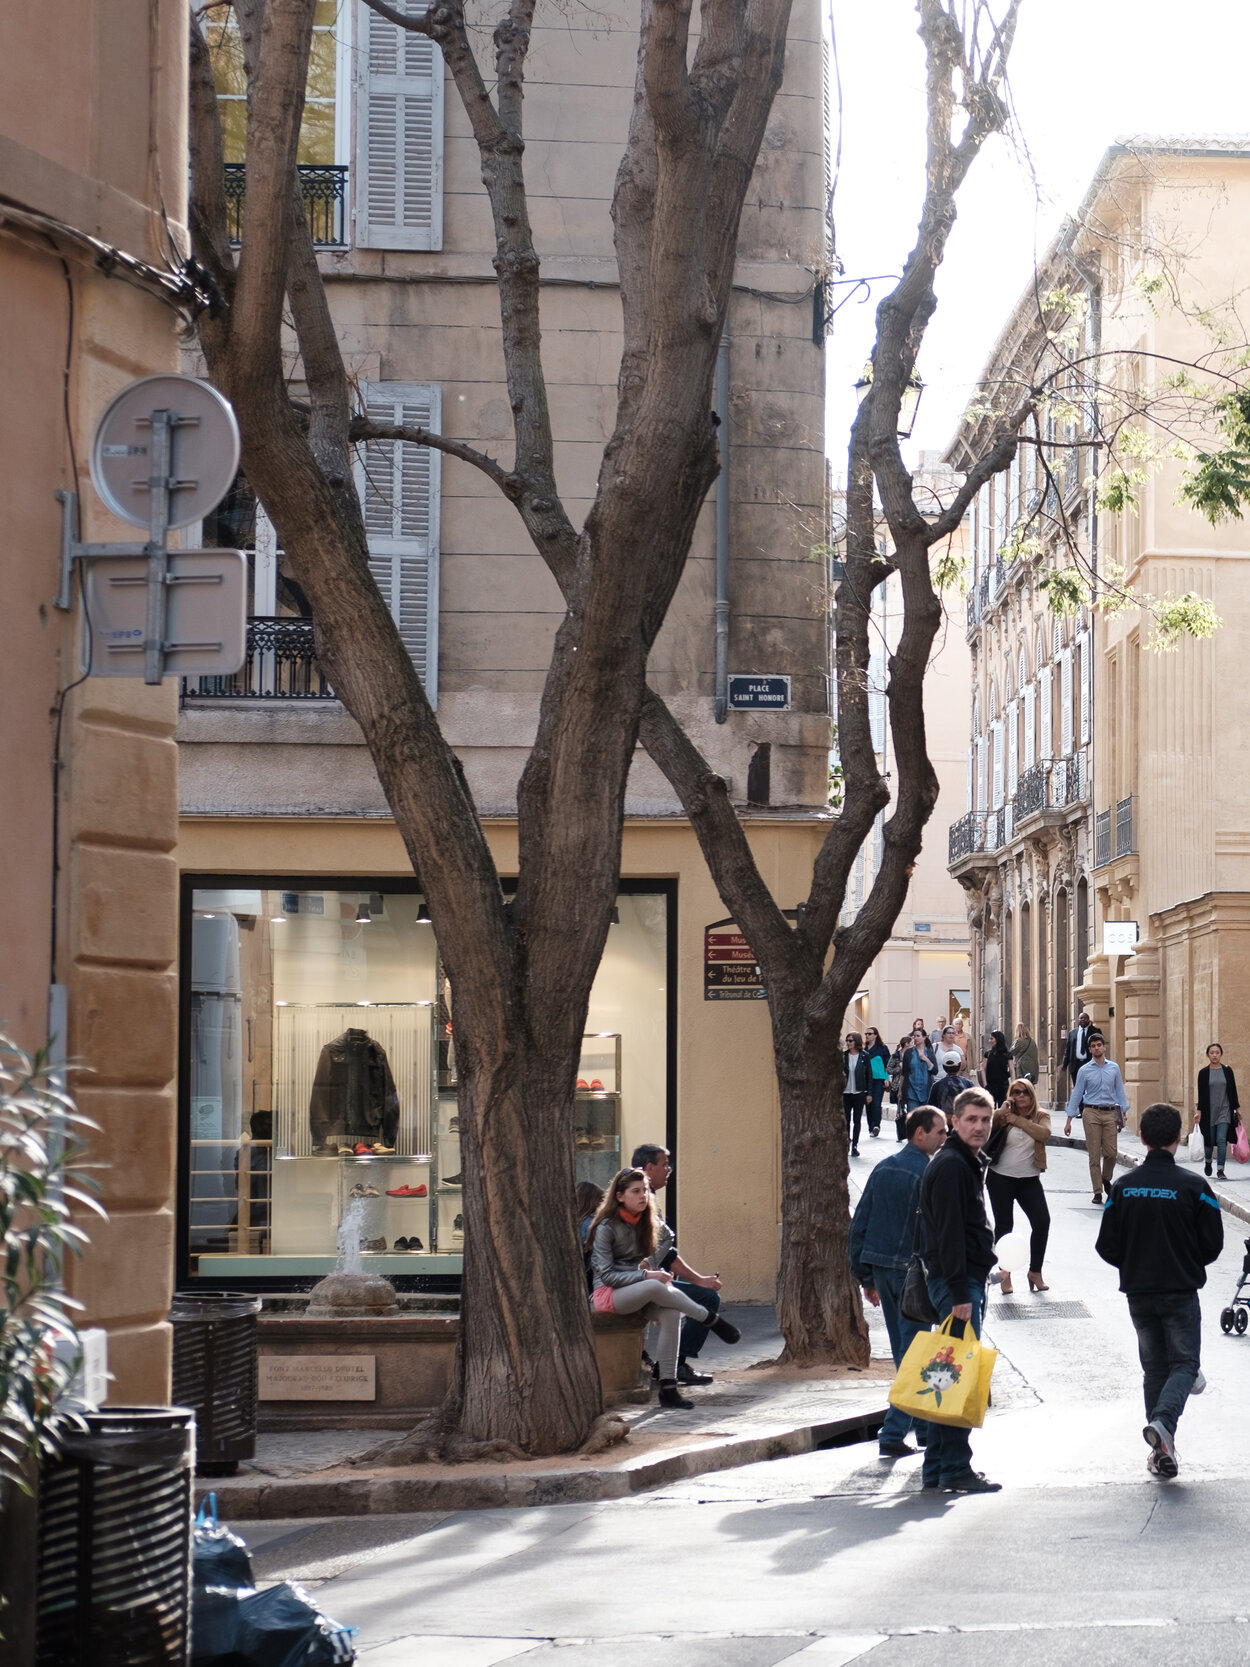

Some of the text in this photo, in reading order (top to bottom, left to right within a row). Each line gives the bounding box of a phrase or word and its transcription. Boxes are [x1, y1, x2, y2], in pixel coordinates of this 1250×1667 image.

[733, 694, 785, 702] SAINT HONORE
[731, 951, 755, 959] Musé
[722, 965, 752, 974] Théâtre
[722, 974, 732, 982] du
[747, 974, 757, 982] de
[1122, 1187, 1178, 1200] GRANDEX
